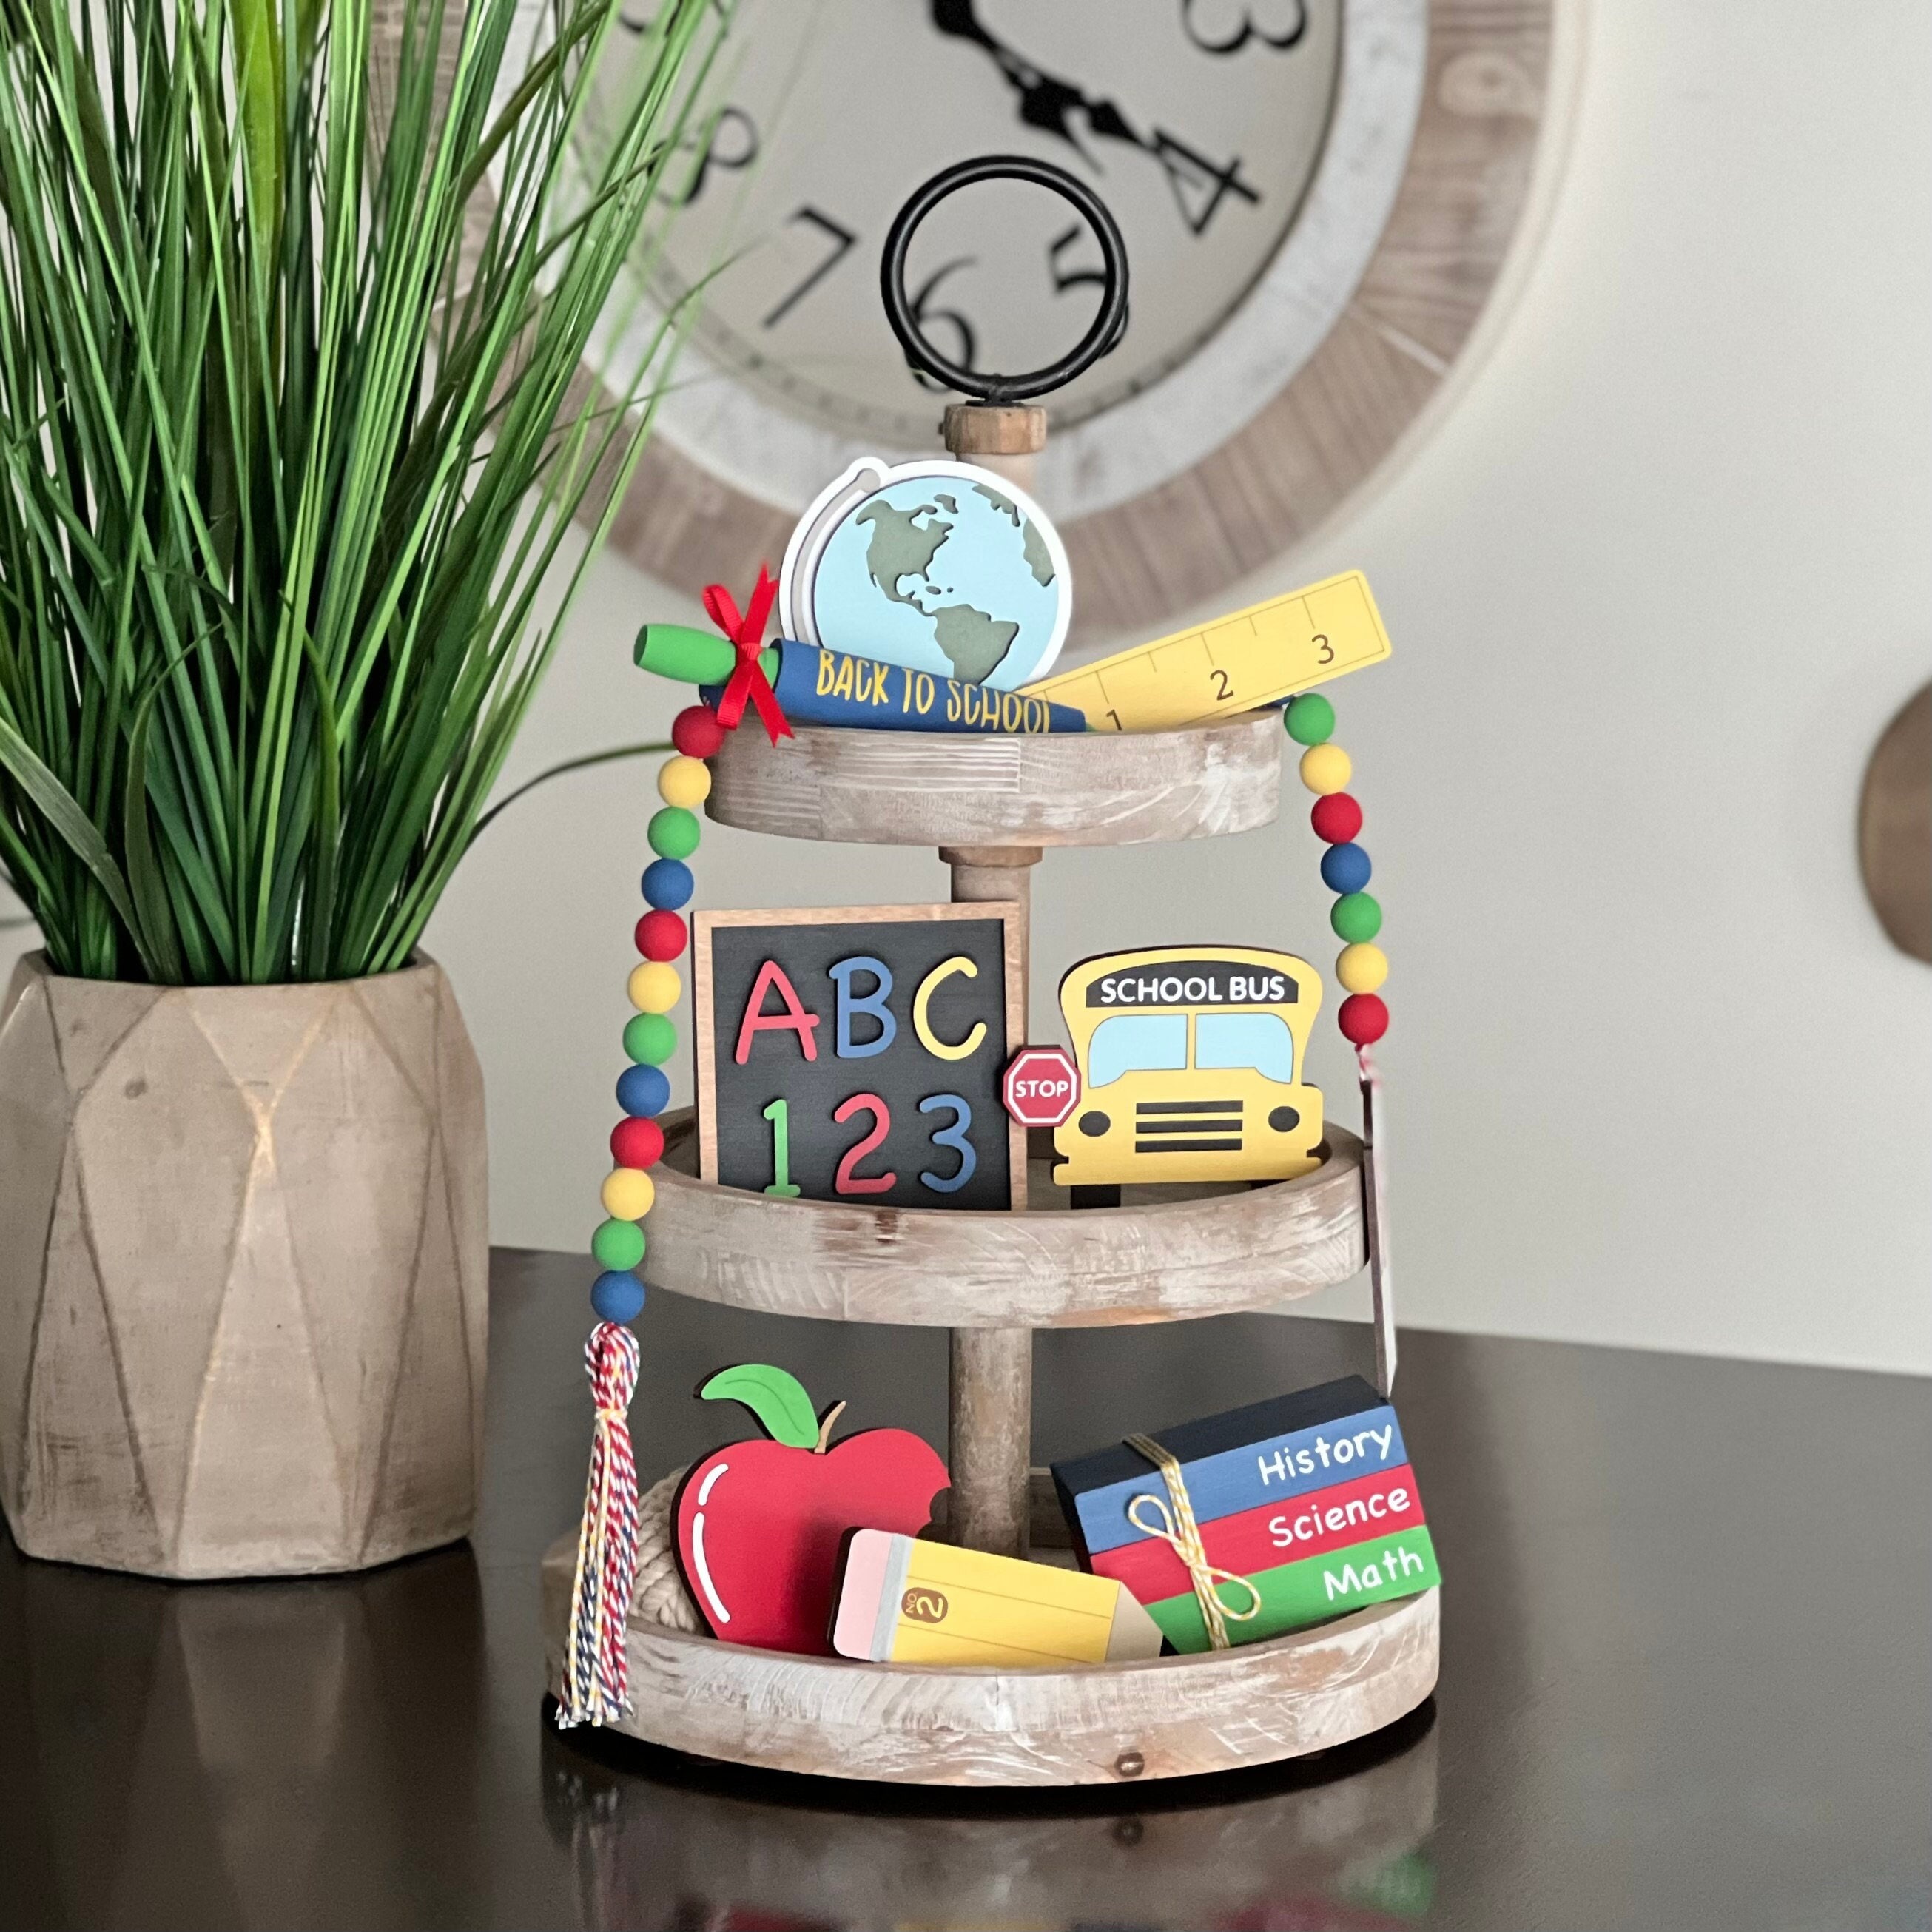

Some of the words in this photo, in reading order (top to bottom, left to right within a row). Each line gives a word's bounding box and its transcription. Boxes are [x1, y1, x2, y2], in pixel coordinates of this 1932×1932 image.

[1152, 127, 1261, 237] 4
[764, 203, 857, 328] 7
[904, 257, 977, 394] 6
[816, 648, 889, 706] BACK
[902, 667, 935, 715] TO
[1105, 708, 1122, 731] 1
[1209, 670, 1234, 701] 2
[1311, 634, 1335, 664] 3
[1100, 977, 1223, 1003] SCHOOL
[1229, 976, 1285, 1000] BUS
[1015, 1080, 1069, 1098] STOP
[1258, 1424, 1392, 1486] History
[1268, 1487, 1410, 1547] Science
[1323, 1546, 1424, 1601] Math
[916, 1596, 943, 1618] 2
